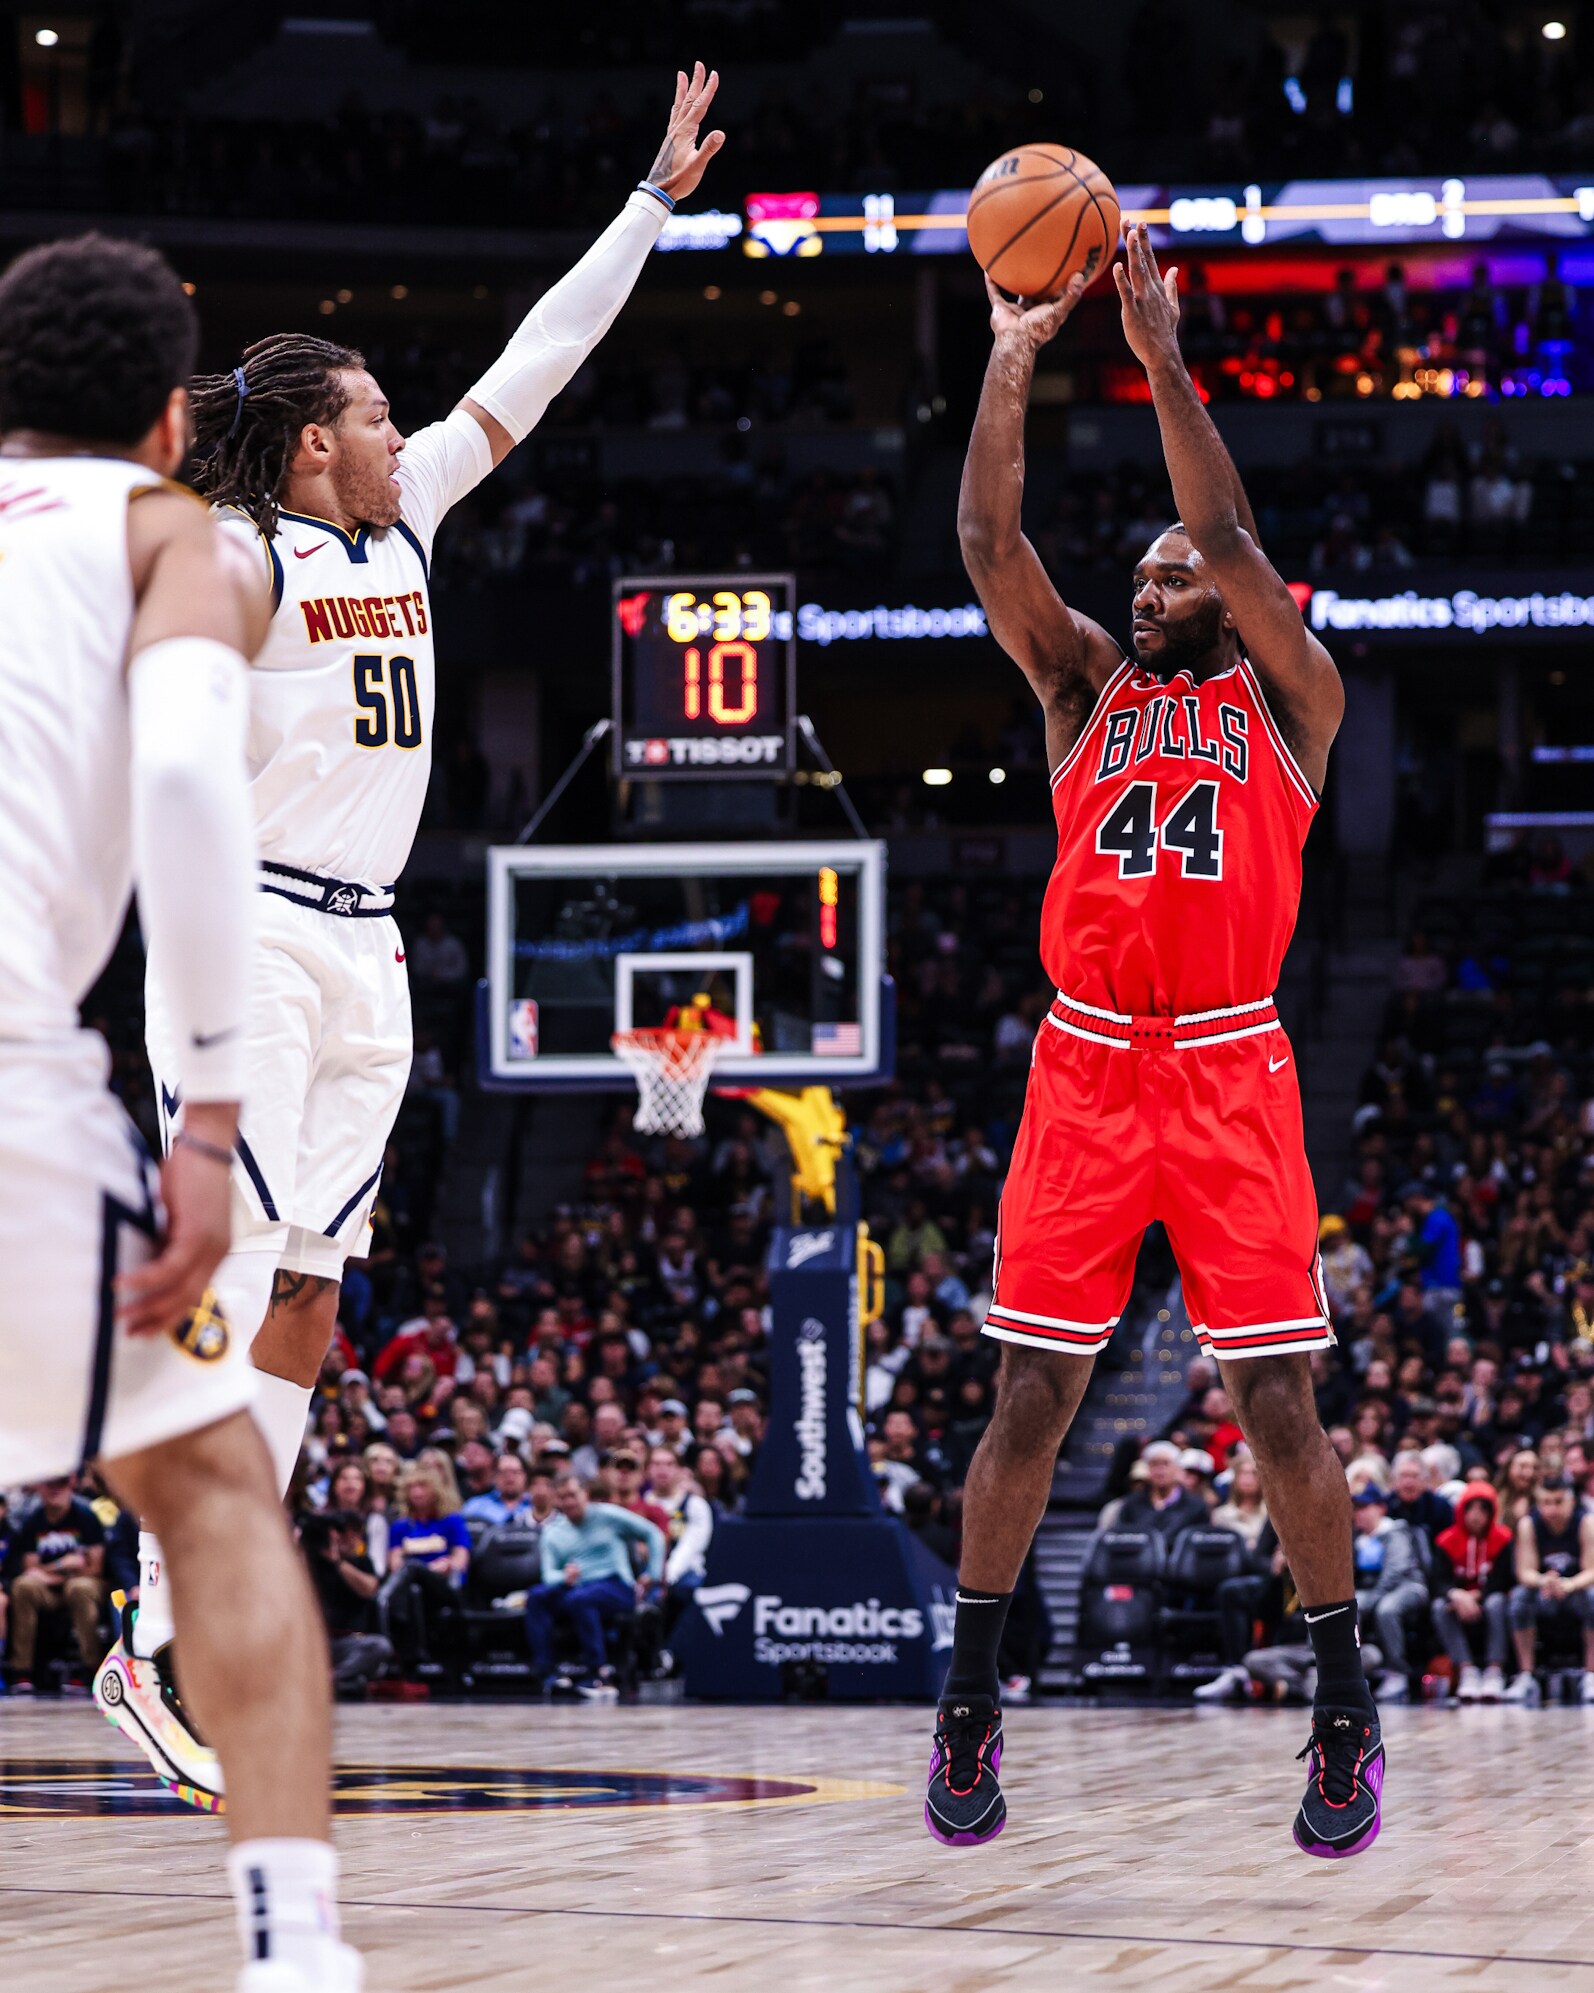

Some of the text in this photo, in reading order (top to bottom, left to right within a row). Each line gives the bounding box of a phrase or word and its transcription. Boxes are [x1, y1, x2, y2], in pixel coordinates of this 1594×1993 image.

[300, 591, 428, 645] NUGGETS
[667, 590, 771, 643] 6:33
[353, 653, 422, 751] 50
[684, 641, 757, 724] 10
[670, 736, 785, 765] TISSOT
[1095, 695, 1248, 785] BULLS
[1095, 779, 1224, 881] 44
[794, 1338, 827, 1500] Southwest
[754, 1595, 924, 1638] Fanatics
[754, 1637, 899, 1668] Sportsbook
